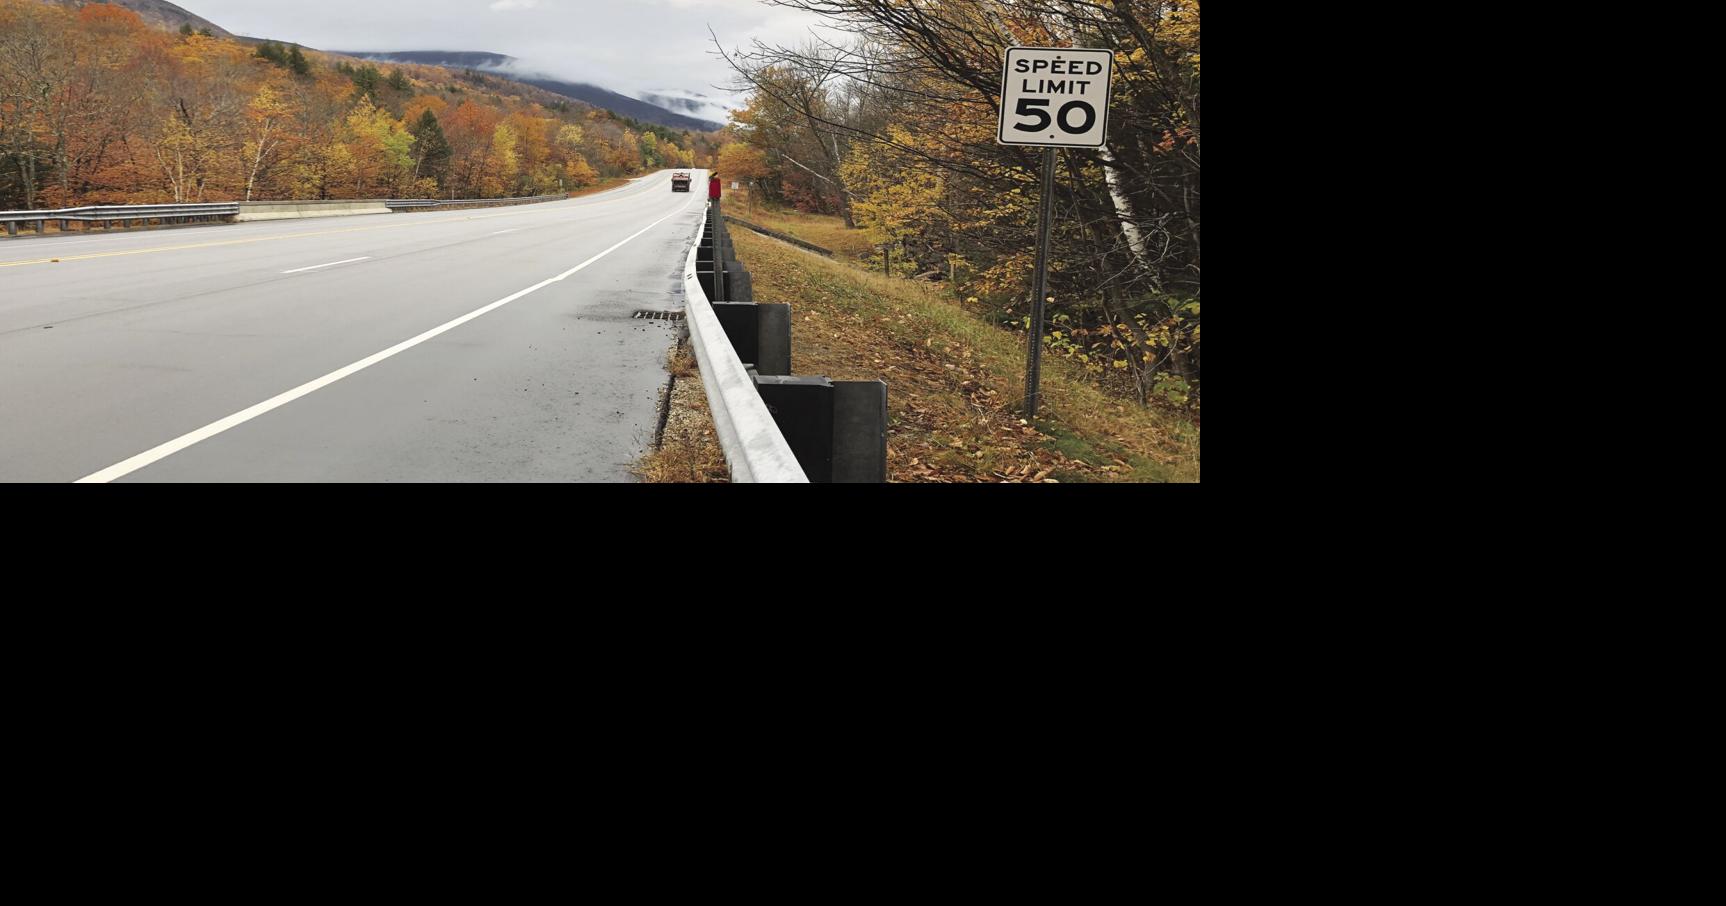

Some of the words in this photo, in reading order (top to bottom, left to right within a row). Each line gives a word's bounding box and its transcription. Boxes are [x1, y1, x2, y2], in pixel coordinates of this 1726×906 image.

[1014, 58, 1103, 76] SPEED
[1021, 79, 1091, 95] LIMIT
[1012, 97, 1097, 135] 50
